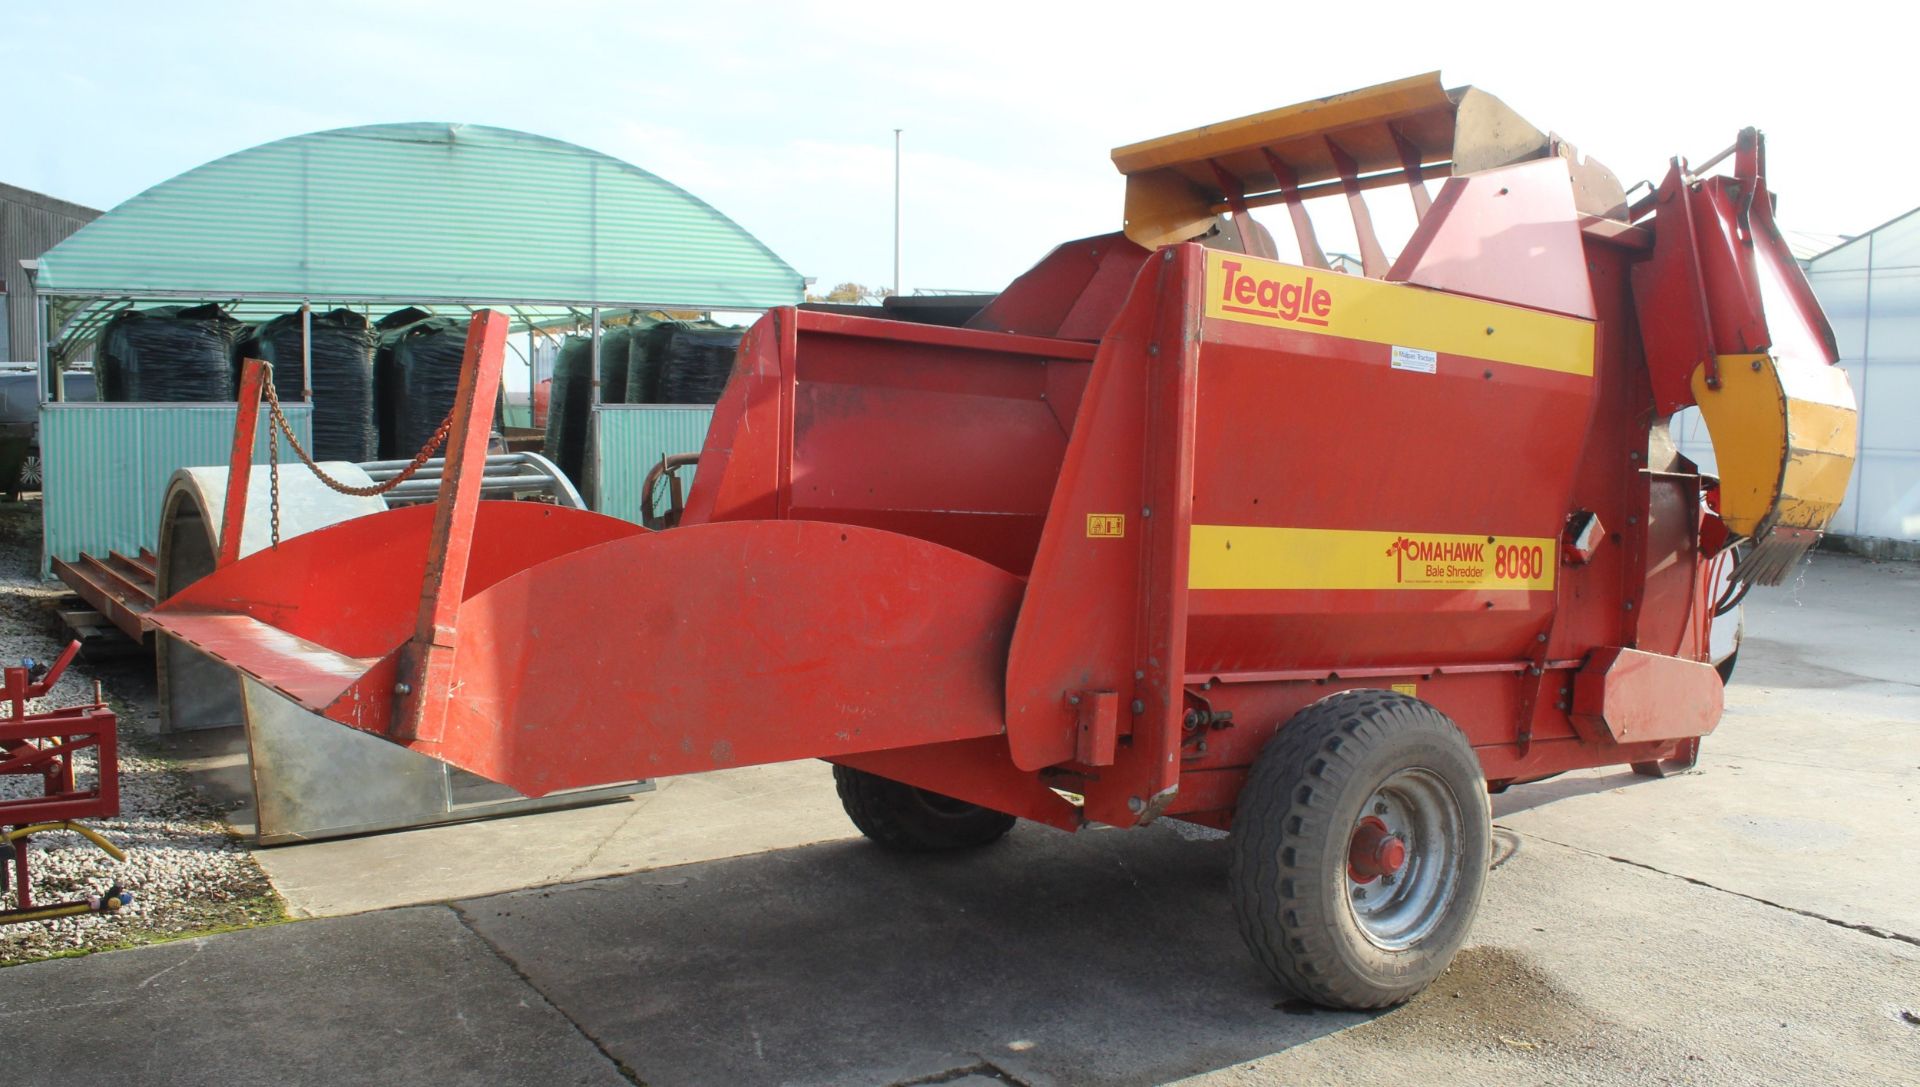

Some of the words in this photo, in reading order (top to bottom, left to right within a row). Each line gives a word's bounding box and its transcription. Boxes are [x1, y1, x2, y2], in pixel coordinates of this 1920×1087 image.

[1222, 260, 1331, 321] Teagle
[1426, 565, 1444, 577] Bale
[1446, 565, 1484, 578] Shredder
[1495, 545, 1542, 579] 8080
